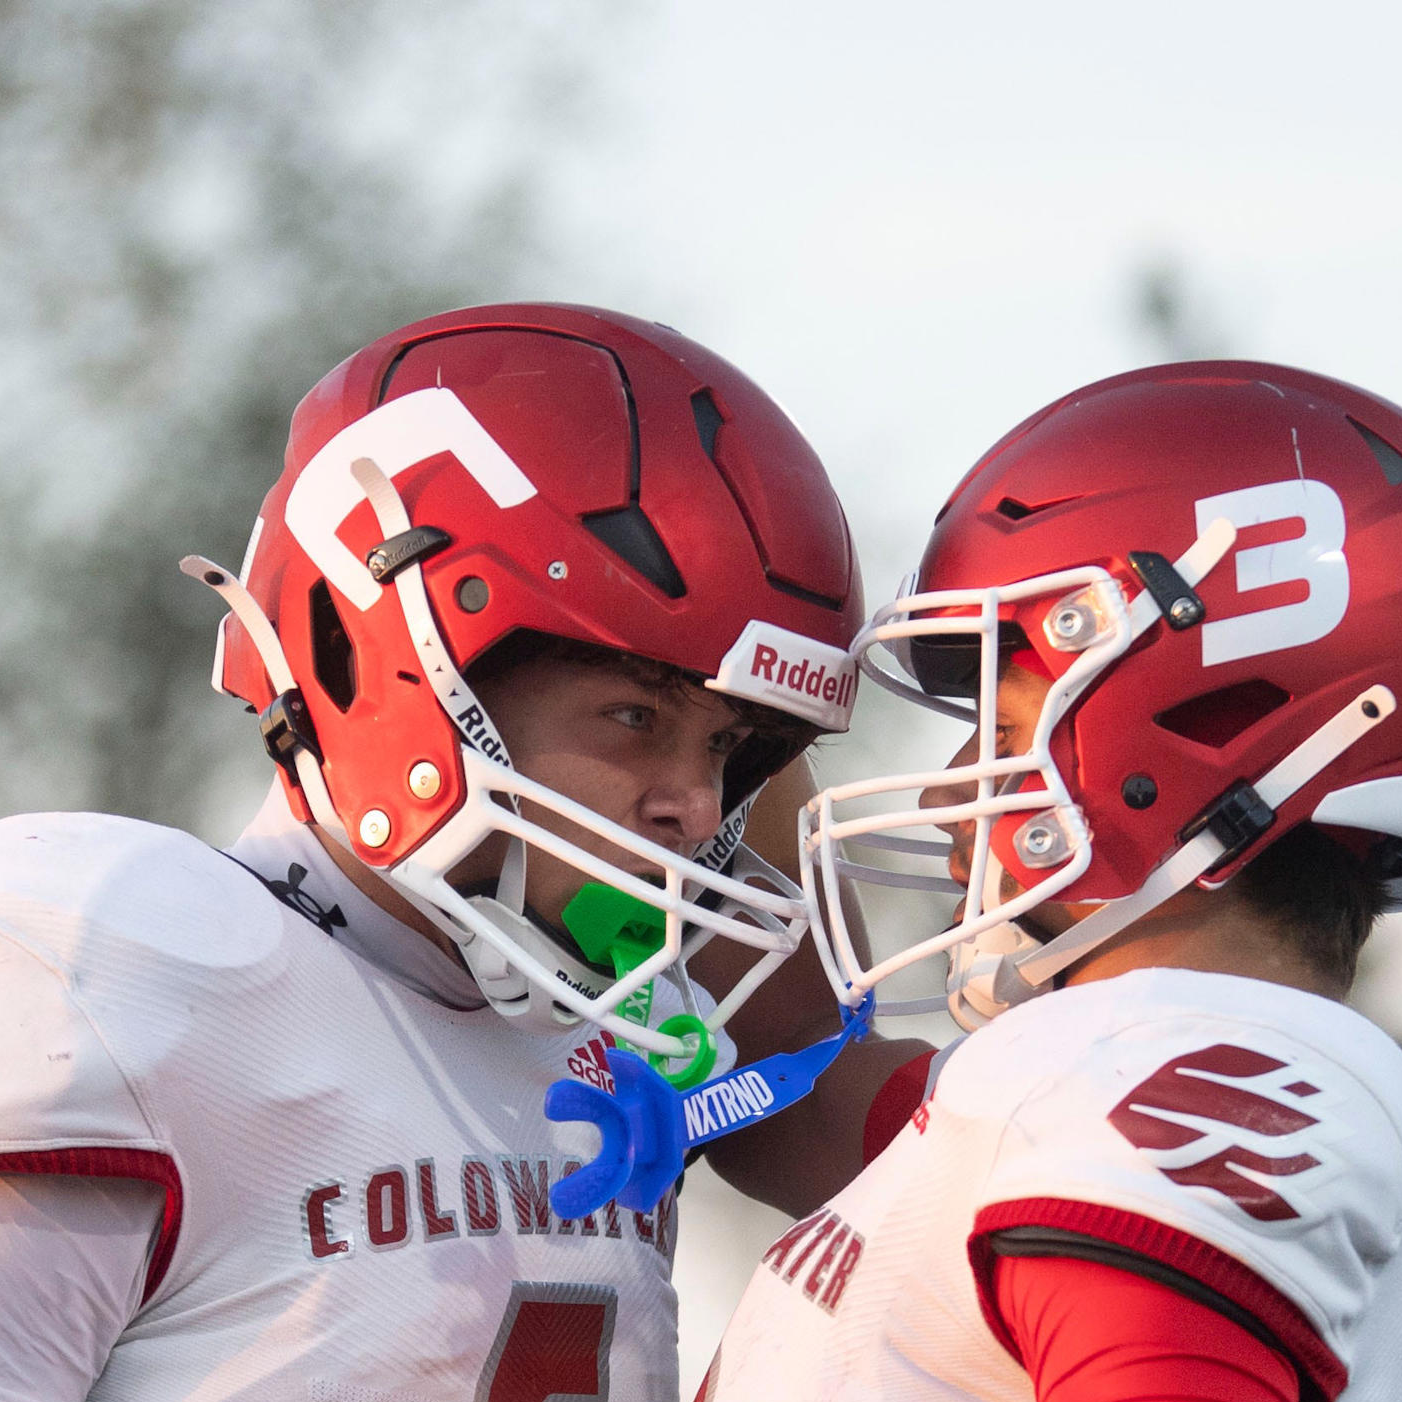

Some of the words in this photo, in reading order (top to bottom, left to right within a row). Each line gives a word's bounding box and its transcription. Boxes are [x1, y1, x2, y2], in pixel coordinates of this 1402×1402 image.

[1195, 478, 1351, 667] 3
[750, 643, 853, 708] Riddell
[683, 1070, 775, 1141] NXTRND
